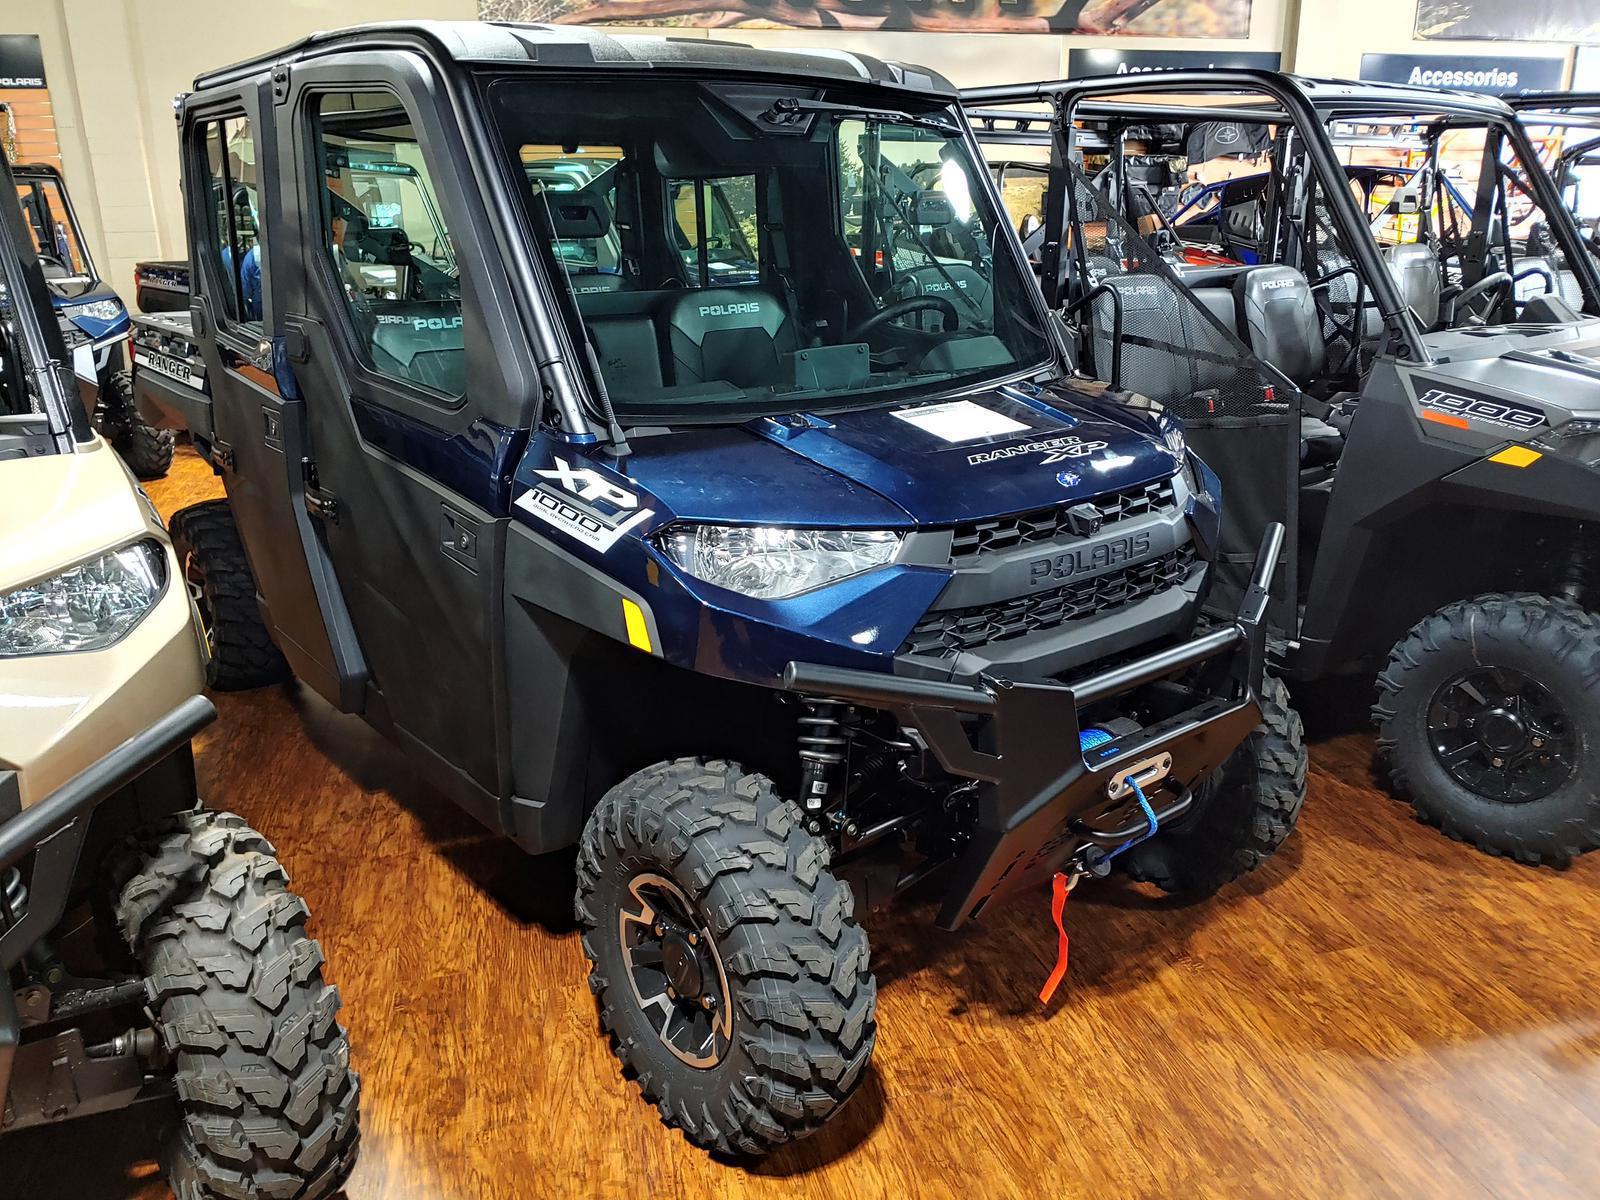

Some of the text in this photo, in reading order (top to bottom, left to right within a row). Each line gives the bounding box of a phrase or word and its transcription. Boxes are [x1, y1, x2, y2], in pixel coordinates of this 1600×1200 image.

[1408, 66, 1518, 88] Accessories
[925, 280, 967, 292] POLAIS
[1262, 279, 1295, 290] POLARIS
[699, 302, 760, 317] POLARIS
[413, 317, 463, 331] POLA
[148, 351, 192, 381] RANGER
[1419, 389, 1546, 429] 1000
[967, 435, 1082, 466] RANGER
[1039, 440, 1109, 466] XP
[532, 455, 639, 510] XP
[530, 489, 602, 533] 1000
[1029, 531, 1151, 586] POLARIS
